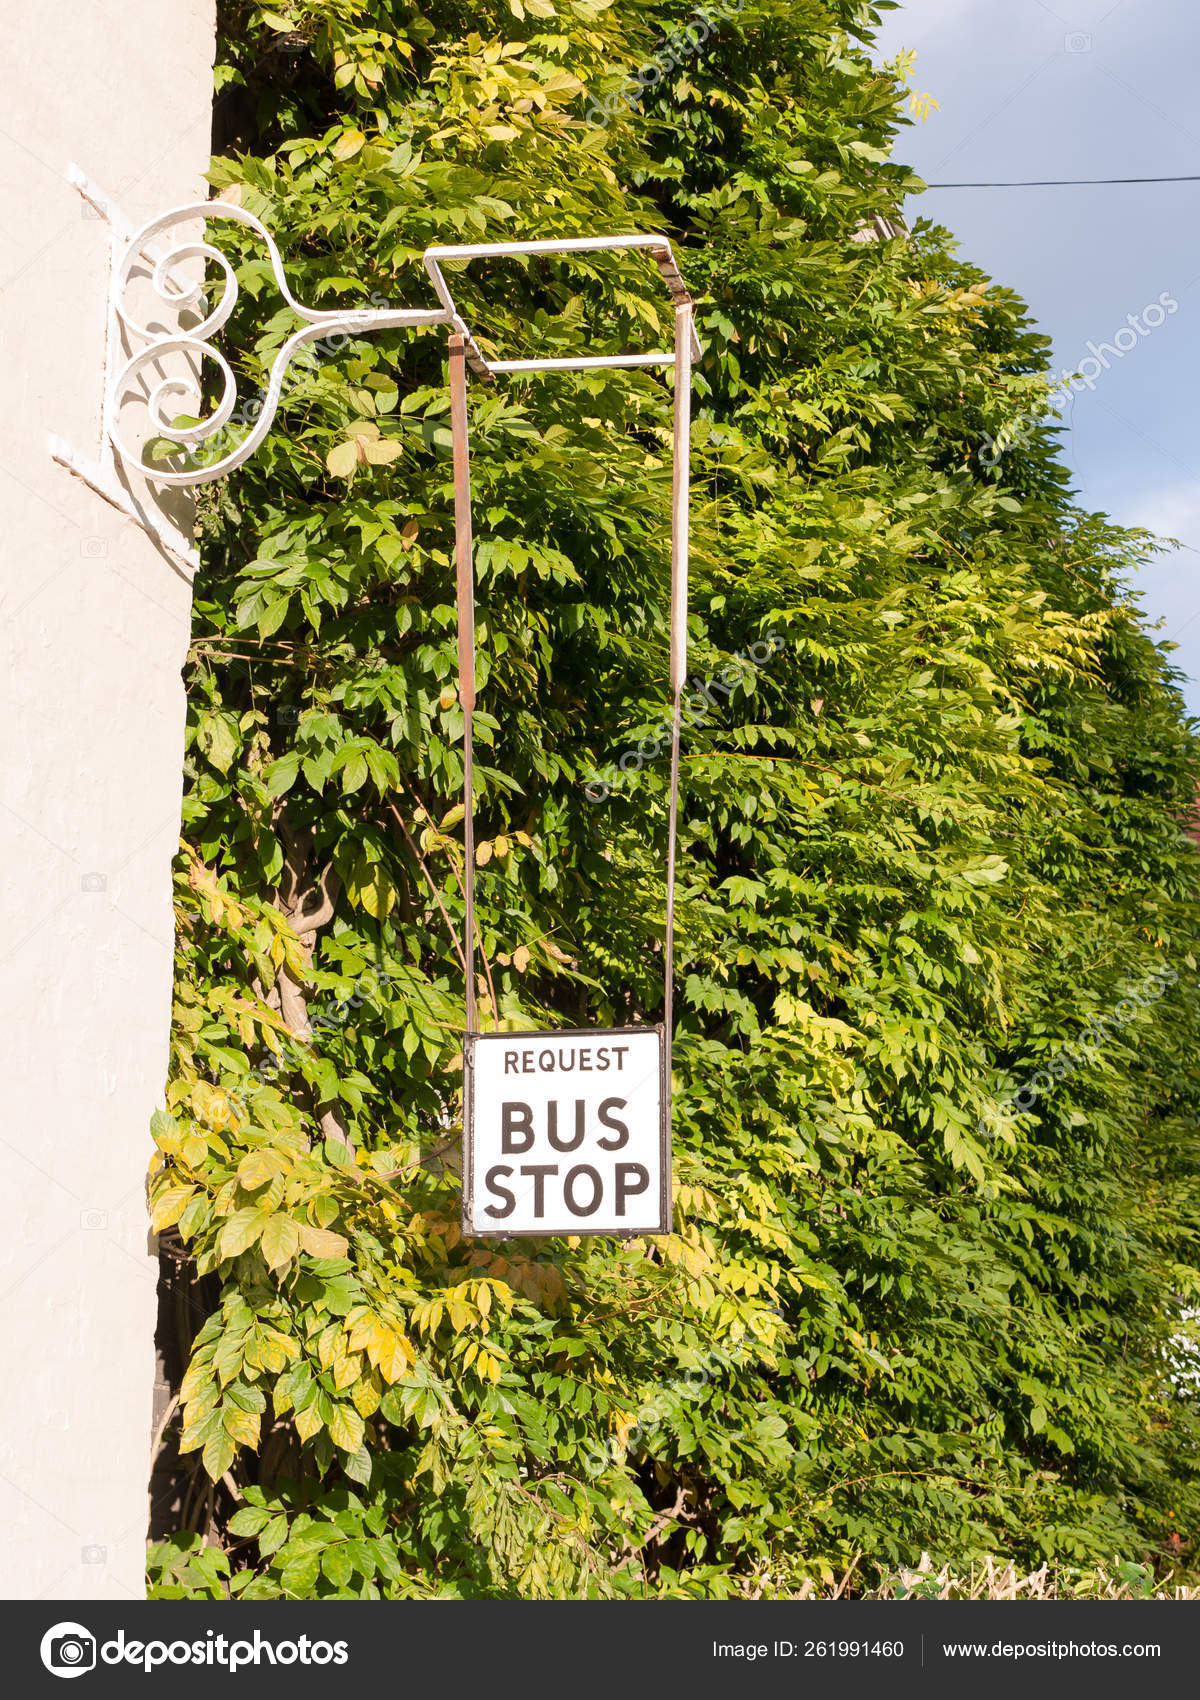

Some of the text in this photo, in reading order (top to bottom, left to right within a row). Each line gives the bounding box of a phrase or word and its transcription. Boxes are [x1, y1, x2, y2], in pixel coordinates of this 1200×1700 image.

[504, 1046, 629, 1075] REQUEST
[501, 1096, 630, 1155] BUS
[483, 1162, 650, 1219] STOP
